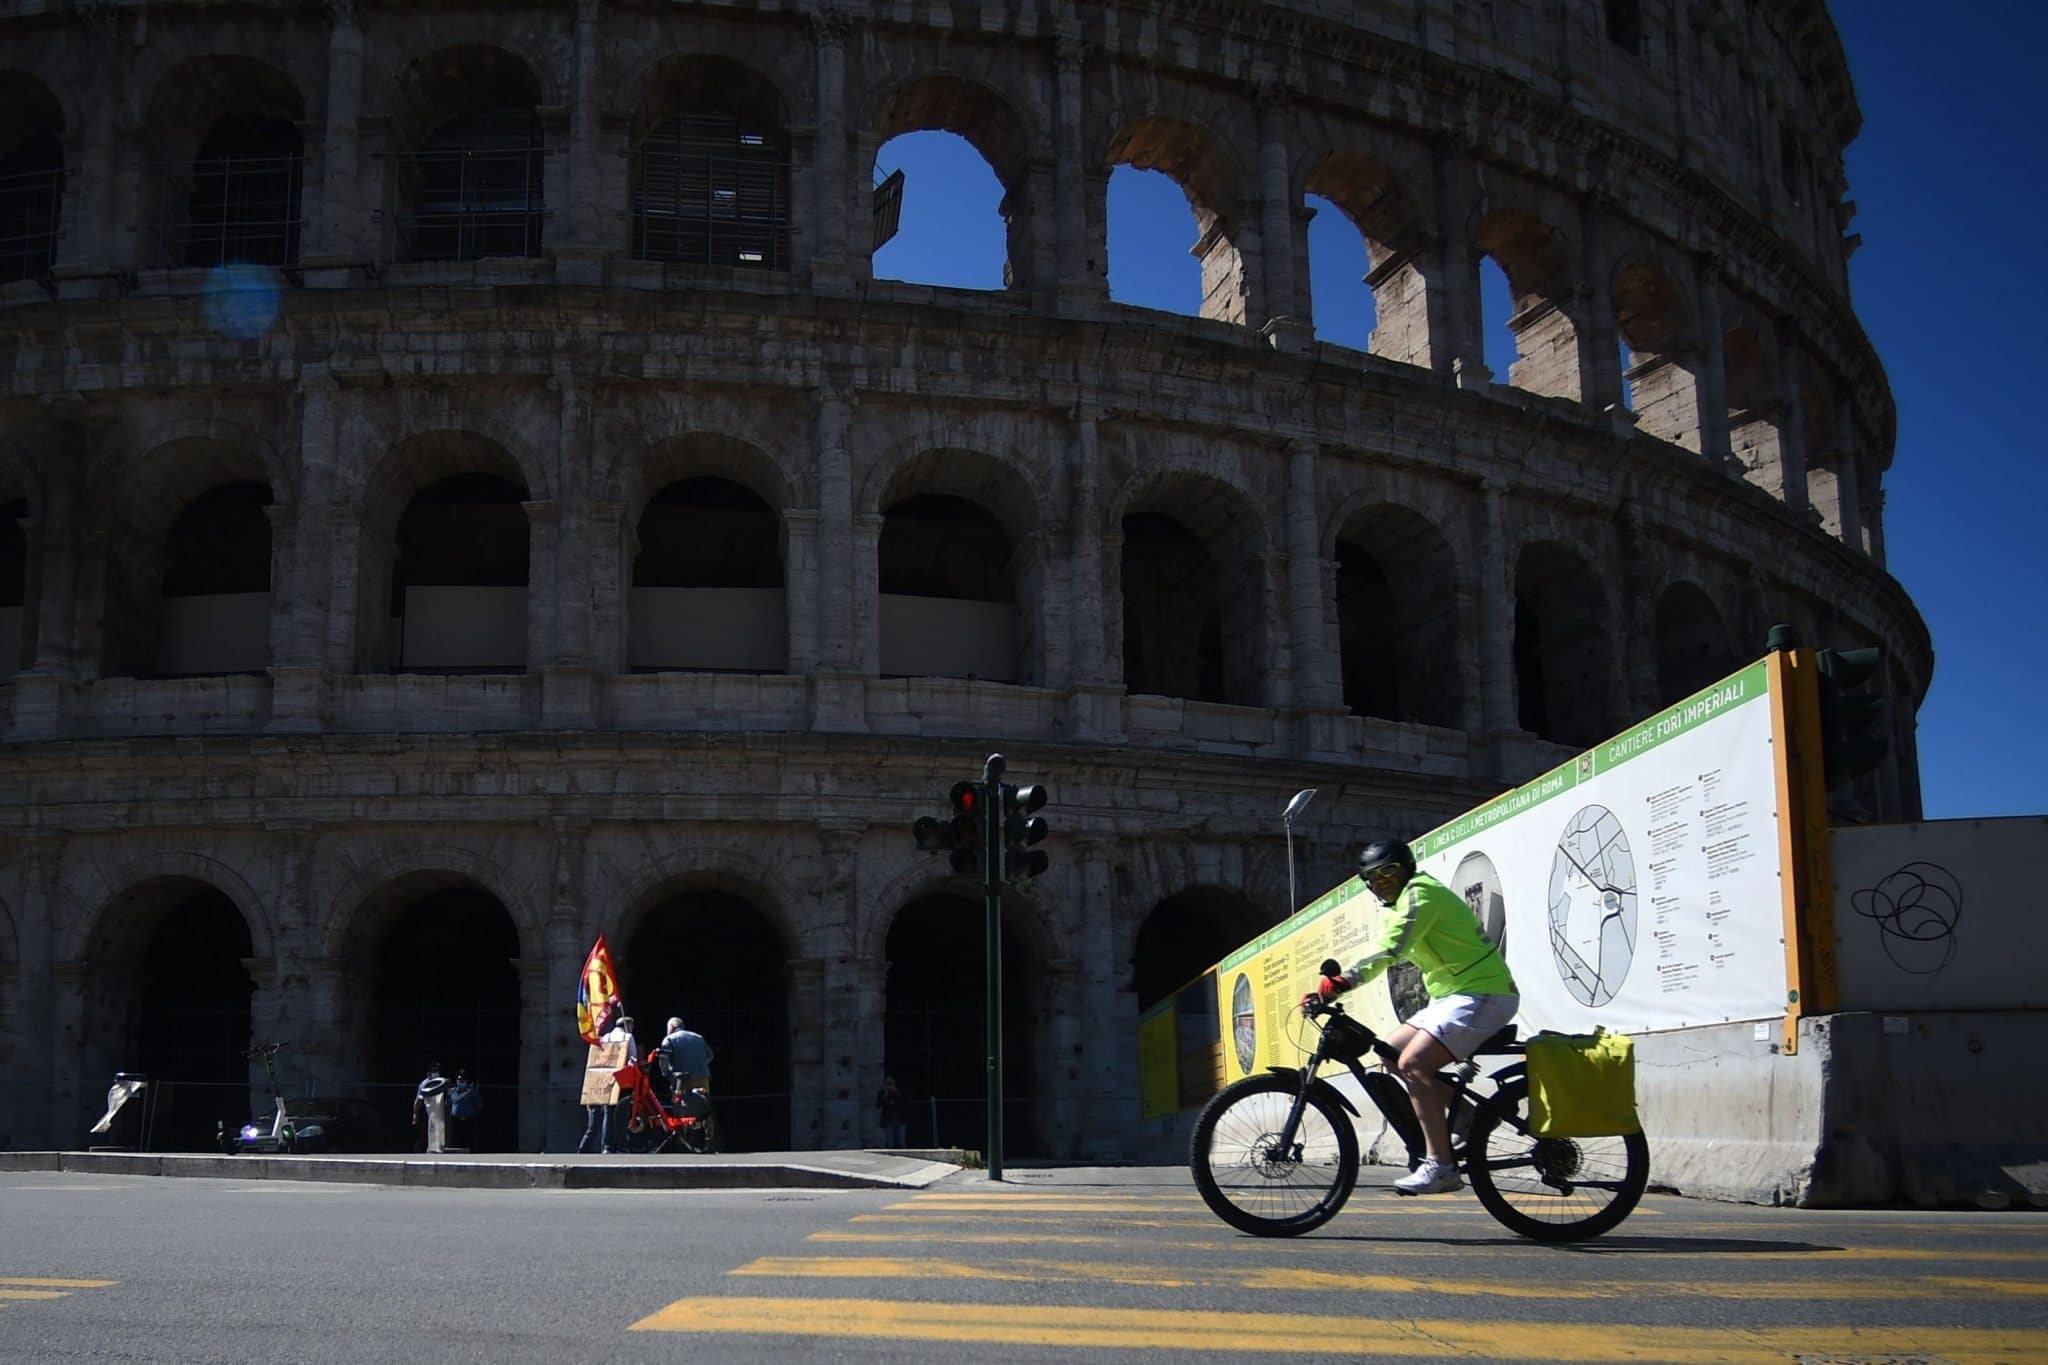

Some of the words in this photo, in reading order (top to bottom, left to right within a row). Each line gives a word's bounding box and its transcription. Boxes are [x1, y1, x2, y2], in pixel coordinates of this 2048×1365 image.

[1609, 727, 1654, 762] CANTIERE
[1657, 715, 1681, 738] FORI
[1684, 680, 1744, 724] IMPERIALI
[1433, 833, 1449, 849] LINEA
[1456, 820, 1476, 838] DELLA
[1475, 791, 1531, 830] METROPOLITANA
[1531, 787, 1540, 802] DI
[1541, 776, 1563, 797] ROMA
